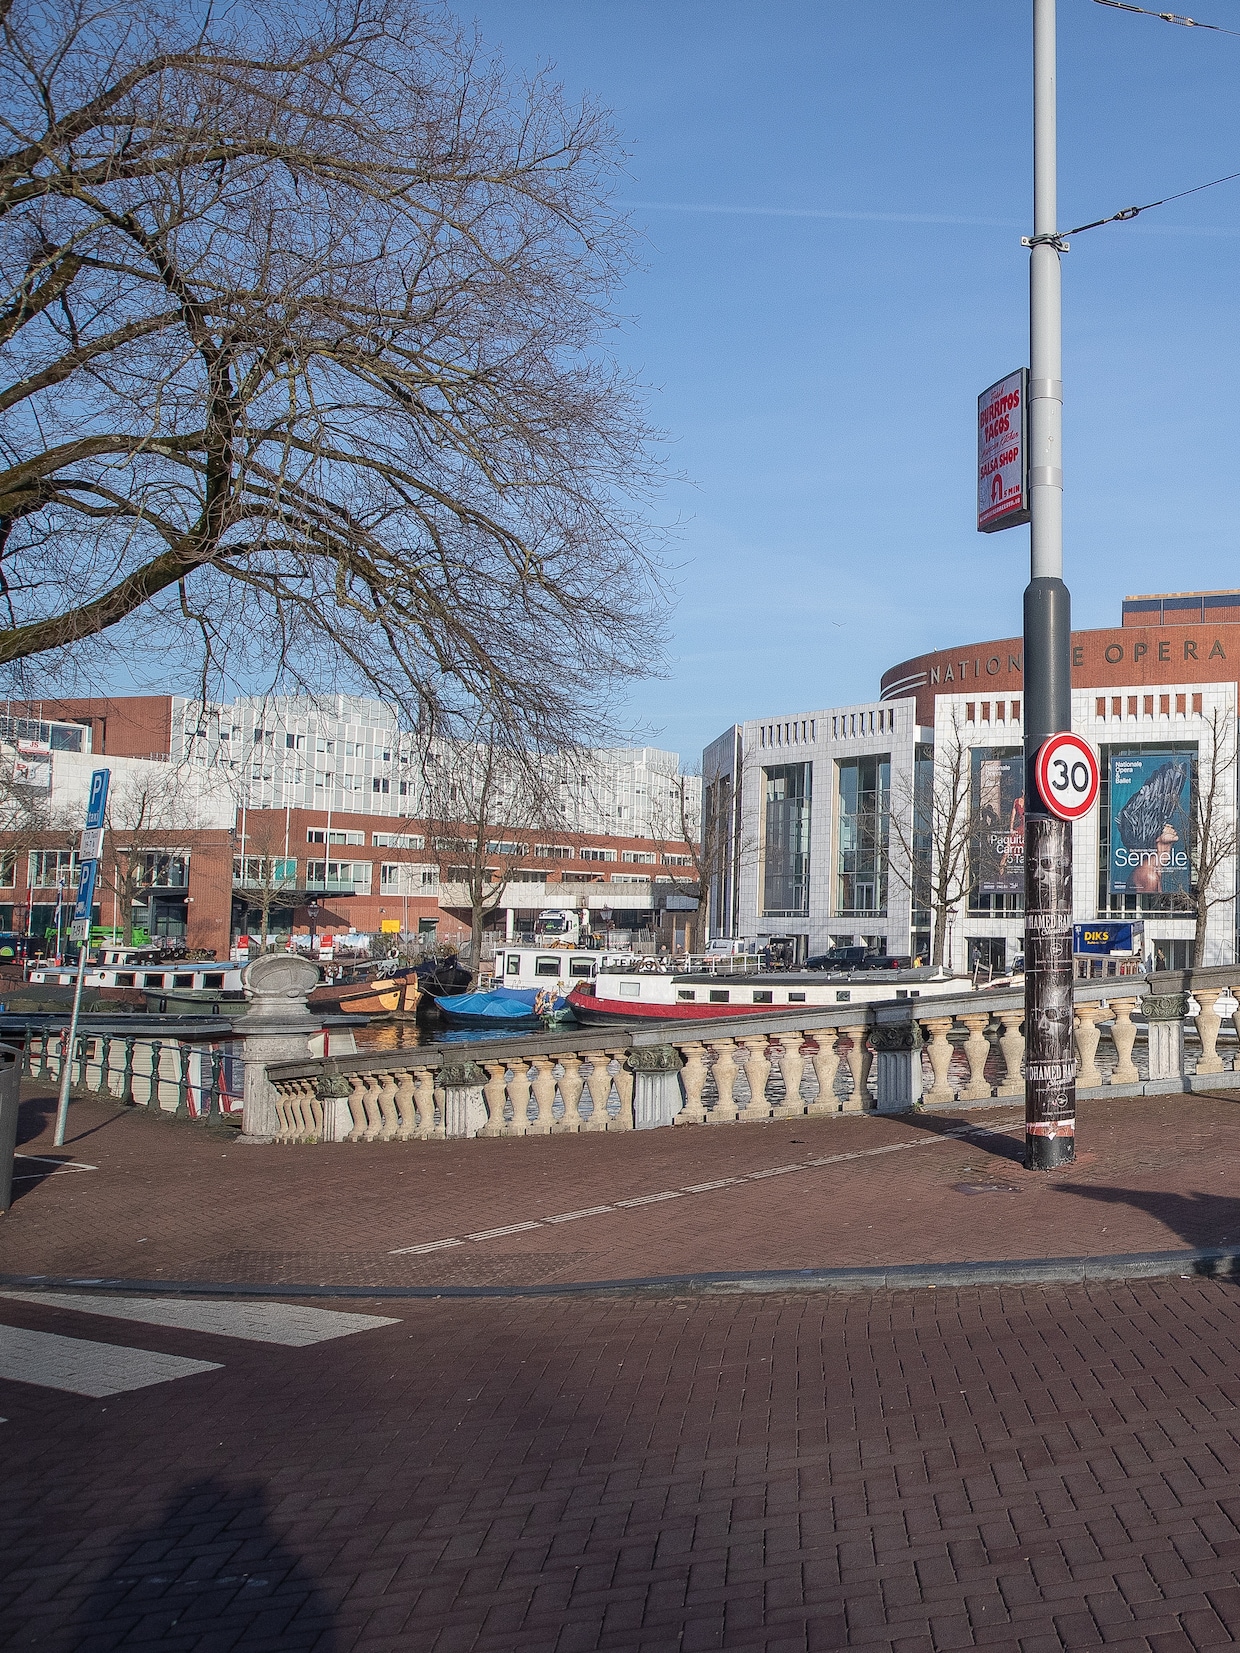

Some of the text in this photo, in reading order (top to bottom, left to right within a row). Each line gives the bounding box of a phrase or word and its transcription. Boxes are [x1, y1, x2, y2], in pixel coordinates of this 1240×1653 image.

[980, 389, 1019, 429] BURRITOS
[985, 413, 1010, 443] TACOS
[981, 447, 1019, 480] SALSA SHOP
[1008, 484, 1020, 496] MIN
[930, 648, 1084, 685] NATIONE
[1106, 639, 1227, 663] OPERA
[1052, 760, 1089, 792] 30
[88, 811, 99, 822] taxi
[997, 844, 1024, 854] Carm
[1115, 848, 1187, 867] Semele
[1084, 931, 1109, 941] DIKS
